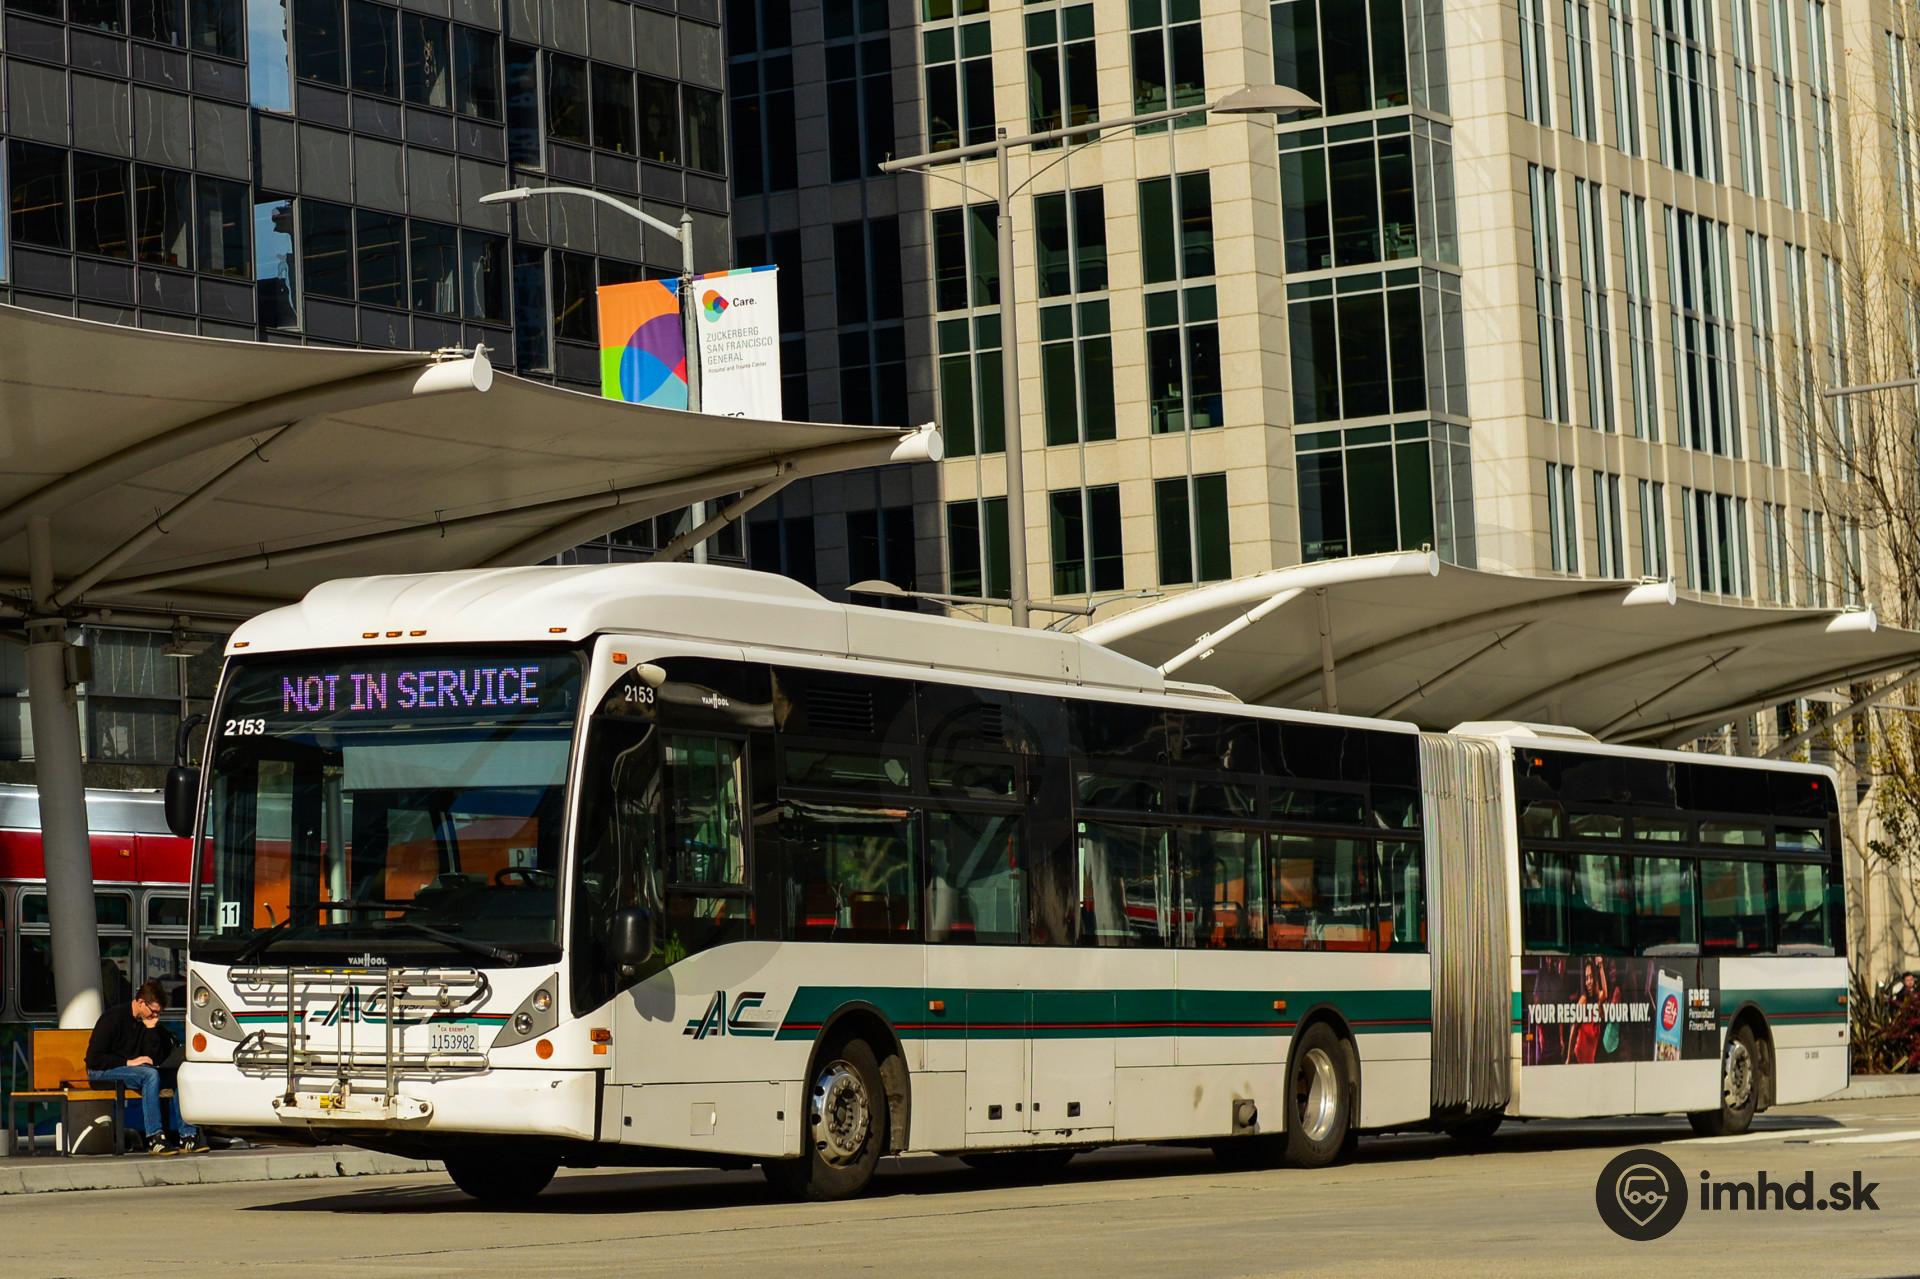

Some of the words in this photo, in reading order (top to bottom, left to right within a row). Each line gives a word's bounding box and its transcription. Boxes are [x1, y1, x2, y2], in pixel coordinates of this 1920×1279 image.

[732, 296, 758, 308] Care.
[706, 326, 759, 342] ZUCKERBERG
[706, 343, 724, 353] SAN
[726, 336, 773, 351] FRANCISCO
[708, 352, 744, 365] GENERAL
[283, 675, 340, 712] NOT
[350, 673, 387, 710] IN
[398, 666, 539, 708] SERVICE
[624, 684, 654, 704] 2153
[224, 719, 265, 736] 2153
[221, 904, 238, 925] 11
[683, 991, 778, 1039] AC
[1528, 1003, 1556, 1024] YOUR
[1557, 1002, 1602, 1023] RESULTS.
[1603, 1002, 1629, 1022] YOUR
[1629, 1002, 1651, 1022] WAY.
[431, 1034, 475, 1050] 1153982
